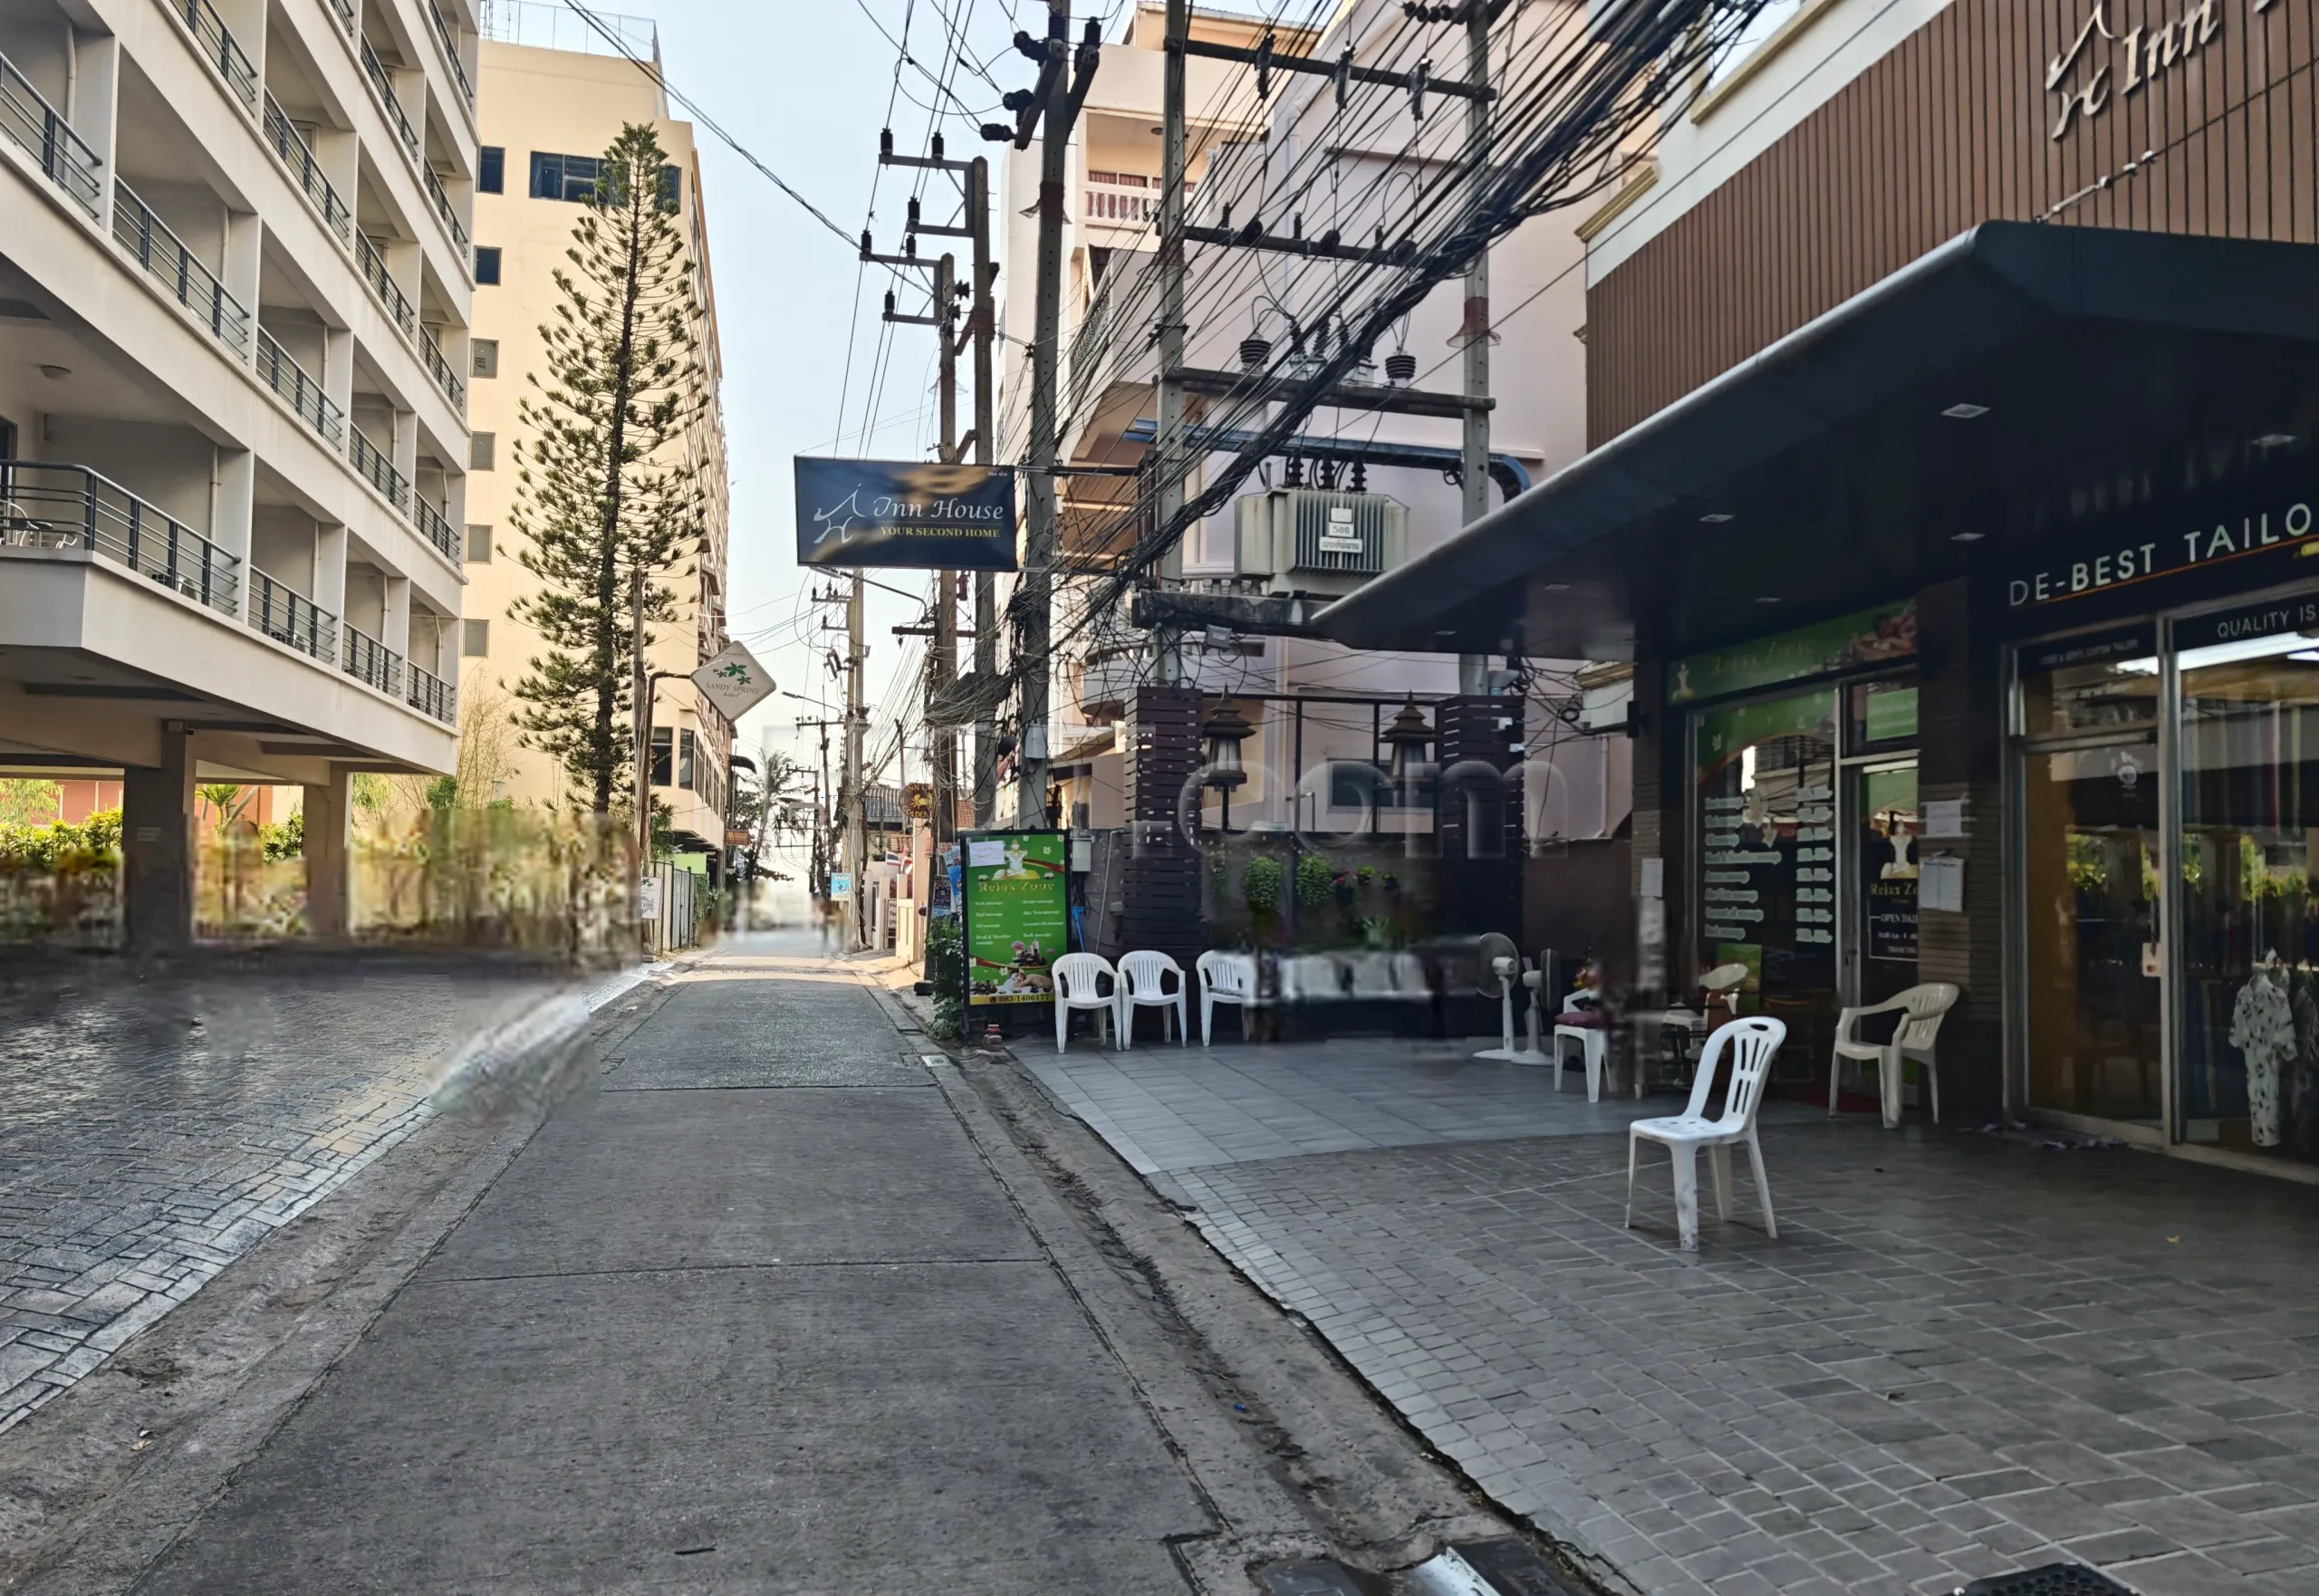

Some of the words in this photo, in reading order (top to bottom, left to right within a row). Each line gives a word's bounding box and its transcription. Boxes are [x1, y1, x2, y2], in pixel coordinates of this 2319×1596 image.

[2120, 0, 2219, 96] Inn
[872, 496, 924, 519] Inn
[929, 497, 1005, 521] House
[880, 525, 913, 536] YOUR
[916, 526, 963, 537] SECOND
[965, 527, 1001, 538] HOME
[2009, 543, 2156, 607] DE-BEST
[2217, 610, 2290, 639] QUALITY
[2300, 604, 2317, 623] IS
[706, 682, 730, 691] SANDY
[733, 685, 759, 695] SPRING
[978, 881, 1016, 896] Relax
[1021, 881, 1055, 892] Zone
